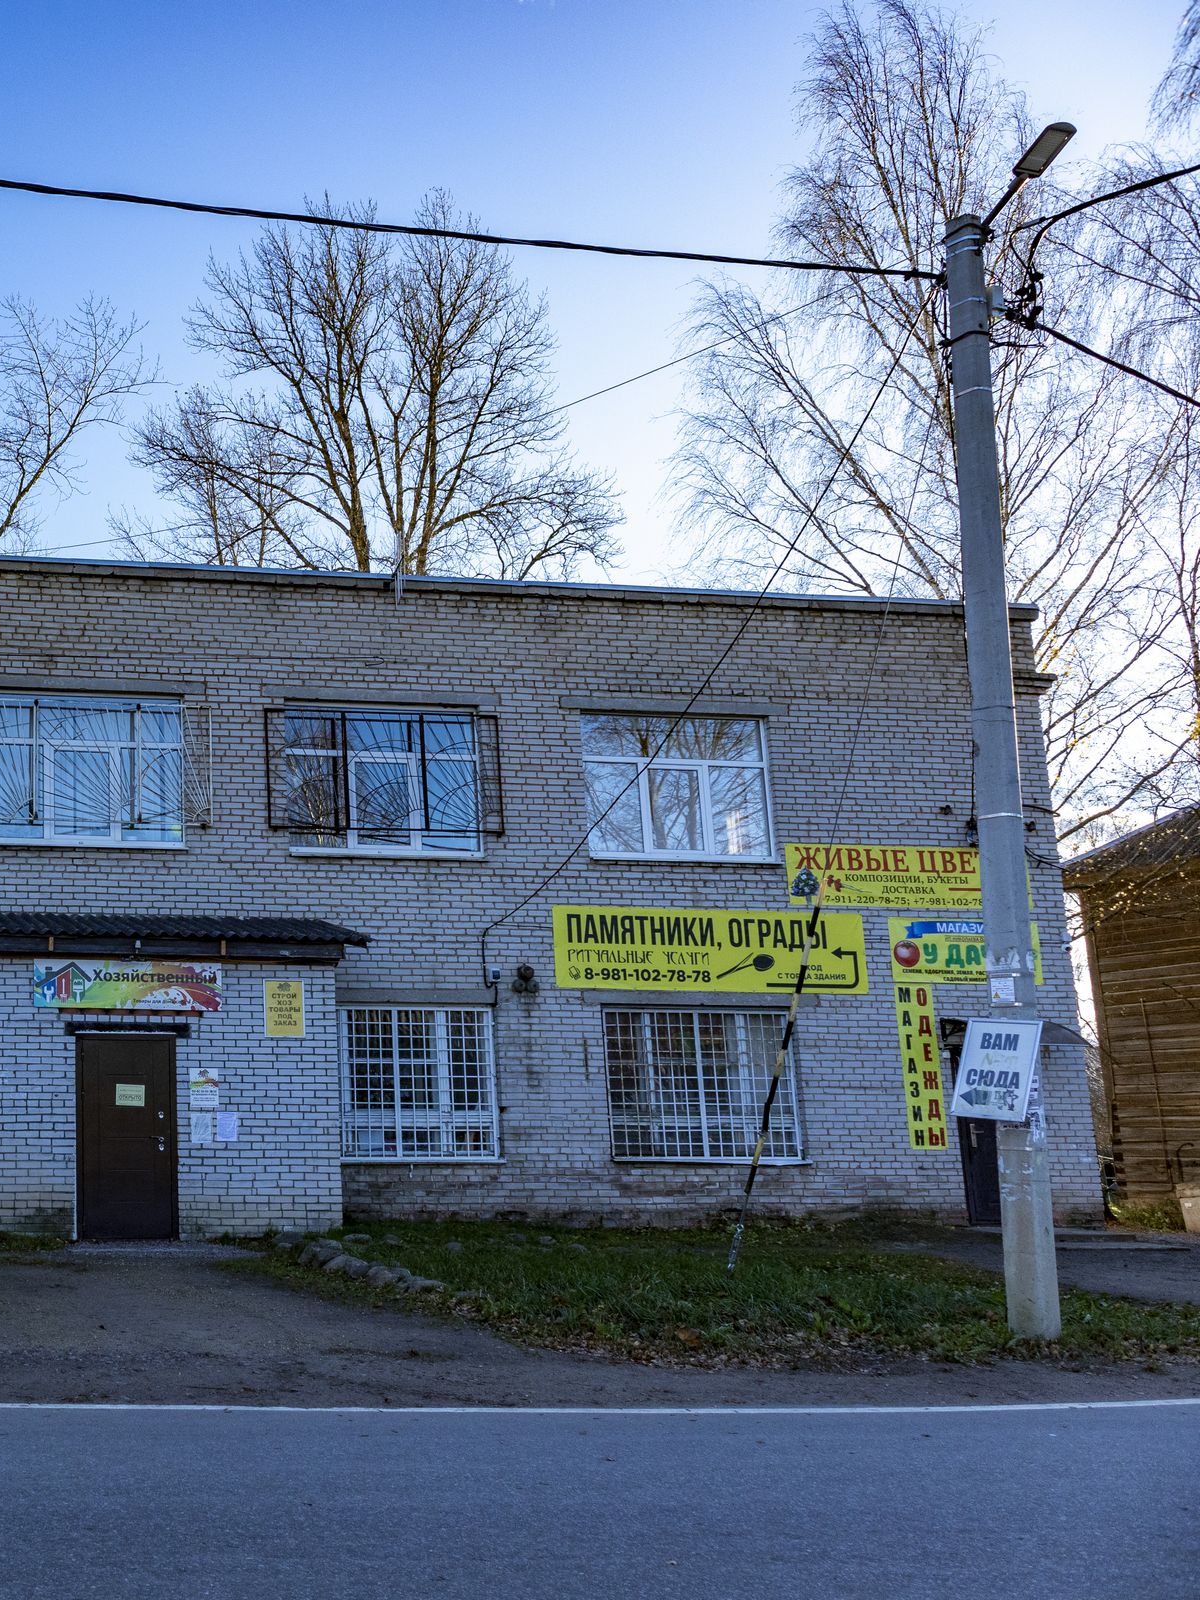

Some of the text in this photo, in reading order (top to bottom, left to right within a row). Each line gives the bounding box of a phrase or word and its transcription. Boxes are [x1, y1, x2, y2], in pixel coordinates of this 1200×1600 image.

[794, 846, 910, 873] ЖИВЫЕ
[845, 873, 969, 885] КОМПОЗИЦИИ, БУКЕТЫ
[881, 886, 936, 895] ДОСТАВКА
[823, 895, 910, 906] 7-911-220-78-75;
[566, 913, 827, 952] ПАМЯТНИКИ, ОГРАДЫ
[567, 949, 710, 966] РИТУАЛЬНЫЕ УСЛУГИ
[93, 968, 217, 984] Хозяйственный
[584, 967, 711, 983] 8-981-102-78-78
[814, 973, 847, 981] ЗДАНИЯ
[980, 1032, 1020, 1051] ВАМ
[898, 987, 925, 1147] МАГАЗИН
[916, 987, 946, 1147] ОДЕЖДЫ
[965, 1068, 1020, 1089] СЮДА
